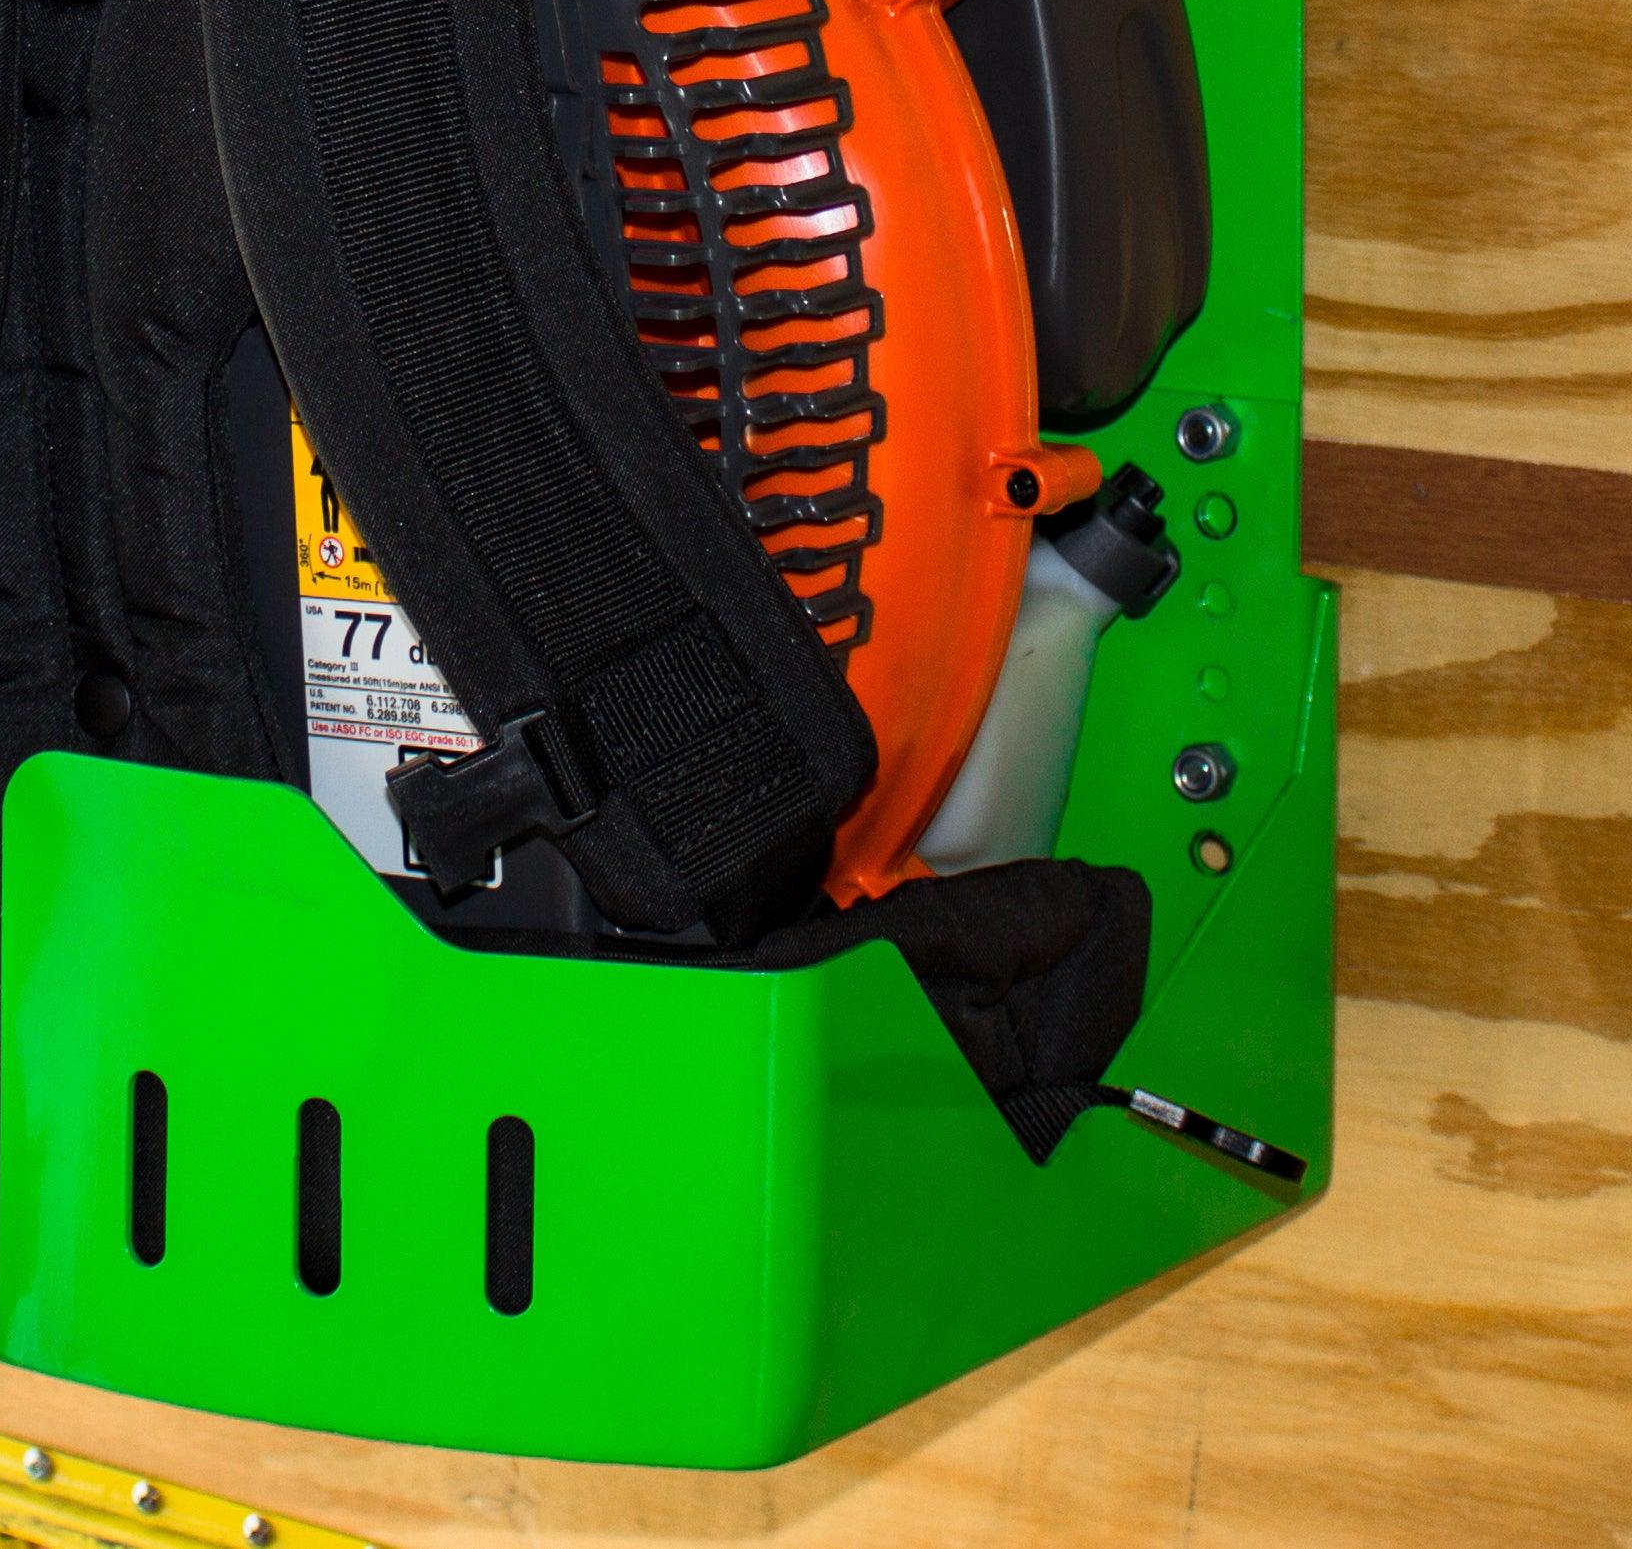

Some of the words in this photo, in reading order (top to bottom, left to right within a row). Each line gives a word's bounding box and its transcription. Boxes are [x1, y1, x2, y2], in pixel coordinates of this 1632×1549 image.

[345, 575, 371, 591] 15m
[305, 605, 323, 615] USA
[334, 609, 393, 661] 77
[308, 658, 346, 672] Category
[308, 672, 350, 684] measured
[352, 676, 361, 685] at
[419, 682, 441, 692] ANSI
[309, 688, 325, 699] U.S.
[310, 700, 341, 712] PATENT
[311, 720, 329, 732] Use
[331, 723, 357, 735] JASO
[358, 726, 372, 737] FC
[373, 729, 384, 737] or
[385, 728, 403, 740] ISO
[427, 734, 454, 746] grade
